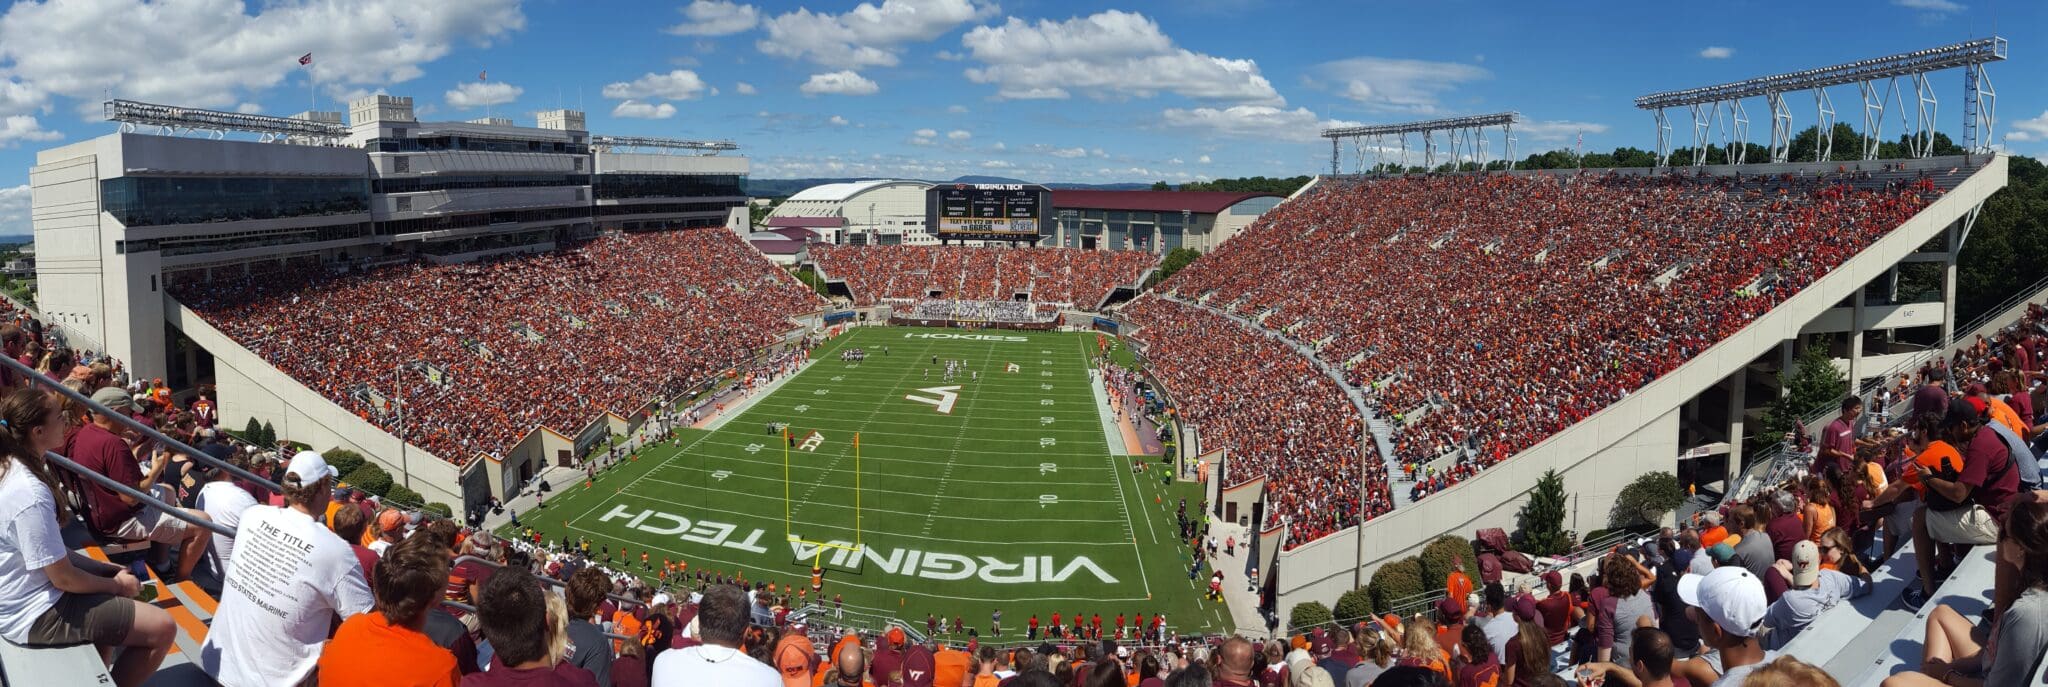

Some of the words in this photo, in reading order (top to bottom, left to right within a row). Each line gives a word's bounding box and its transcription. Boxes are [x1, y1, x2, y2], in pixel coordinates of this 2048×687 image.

[904, 332, 1028, 342] HOKIES
[799, 431, 825, 451] ACC
[1039, 494, 1058, 504] 10
[260, 520, 281, 537] THE
[282, 532, 314, 553] TITLE
[599, 504, 768, 554] TECH
[788, 534, 1120, 583] VIRGINIA
[909, 669, 924, 681] VT
